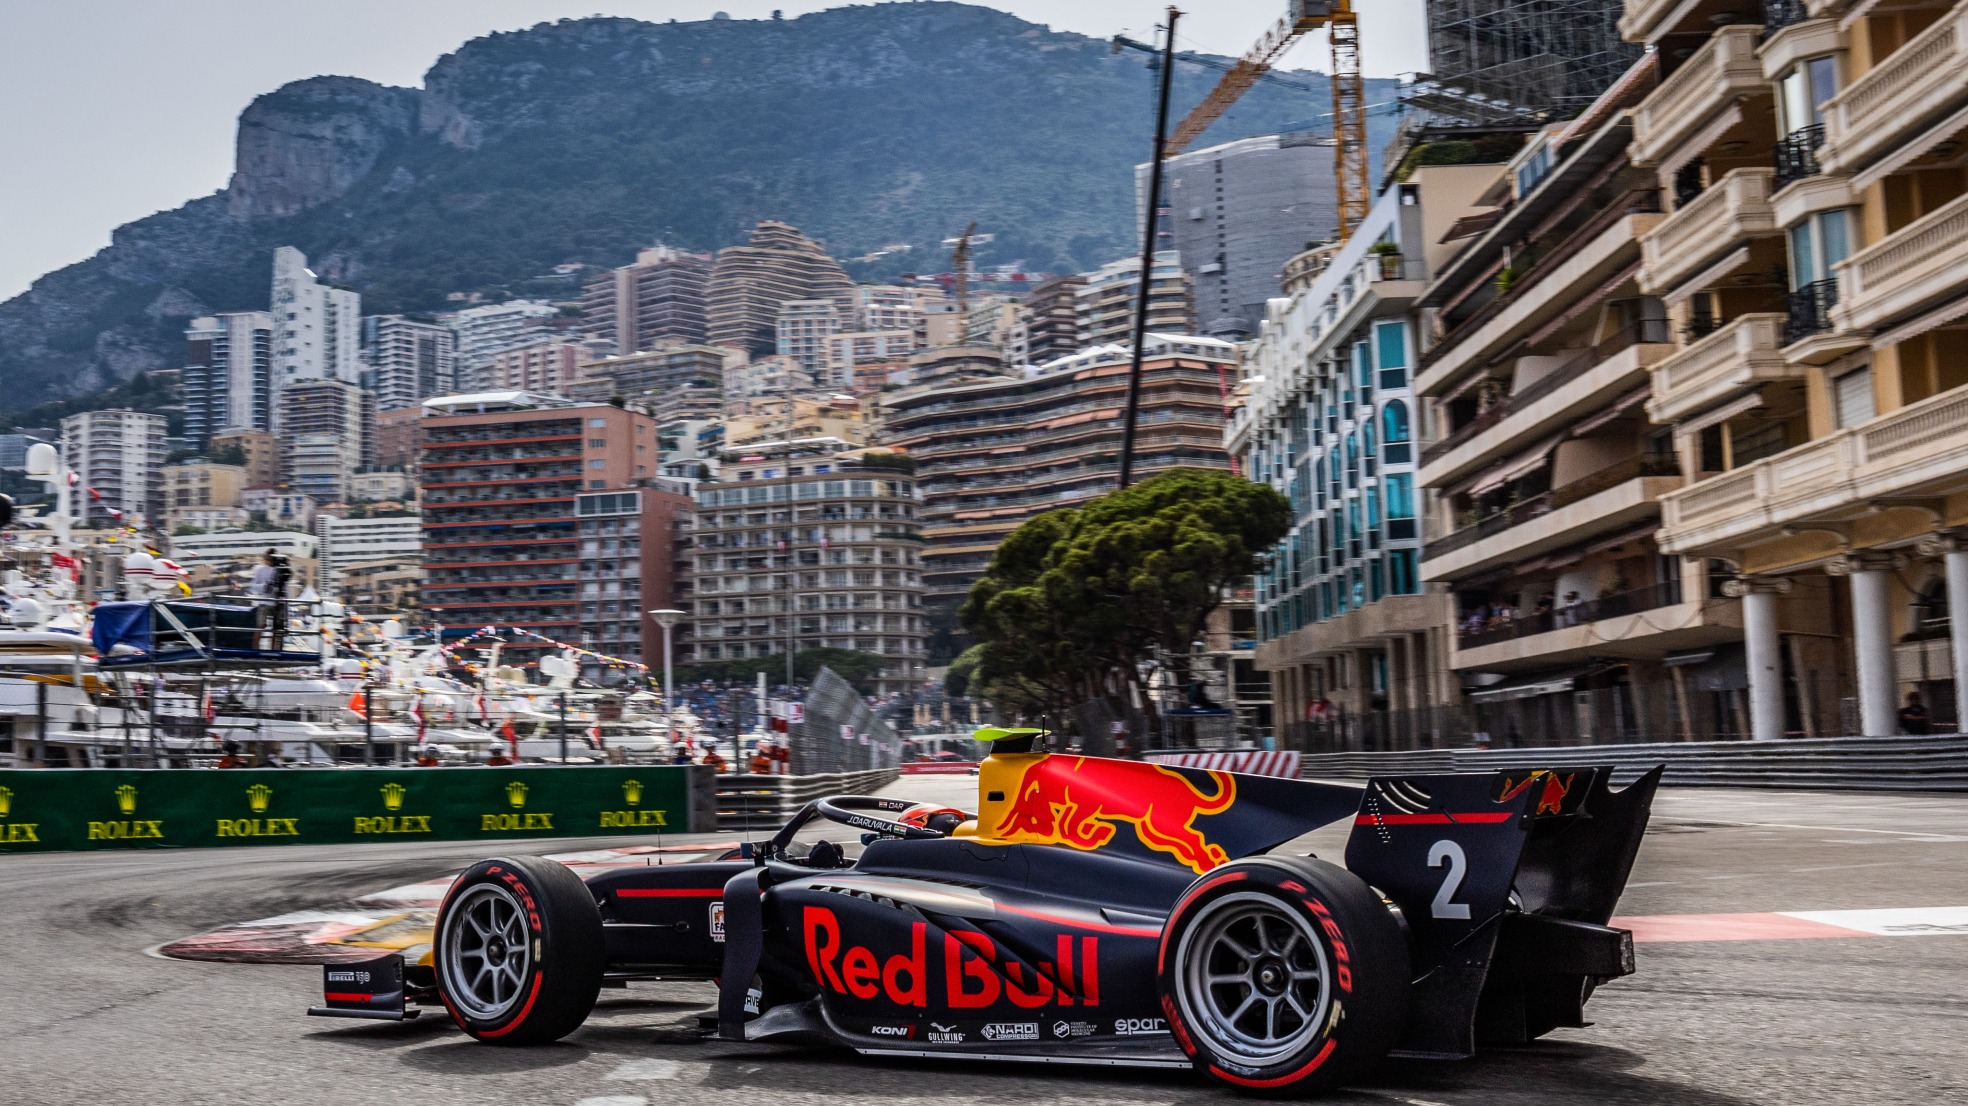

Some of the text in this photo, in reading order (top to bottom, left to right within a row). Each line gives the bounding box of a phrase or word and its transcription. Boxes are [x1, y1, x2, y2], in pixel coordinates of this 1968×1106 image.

[216, 818, 300, 837] ROLEX
[353, 815, 432, 834] ROLEX
[481, 813, 554, 831] ROLEX
[599, 810, 667, 828] ROLEX
[847, 815, 892, 832] J.DARUVALA
[87, 820, 165, 840] ROLEX
[1426, 839, 1472, 920] 2
[501, 872, 542, 932] ZERO
[1302, 897, 1354, 993] ZERO
[803, 905, 1099, 1009] Red Bull
[328, 971, 355, 982] PIRELLI
[871, 1025, 908, 1036] KONI
[928, 1032, 963, 1042] GULLWING
[995, 1024, 1037, 1034] NARDI
